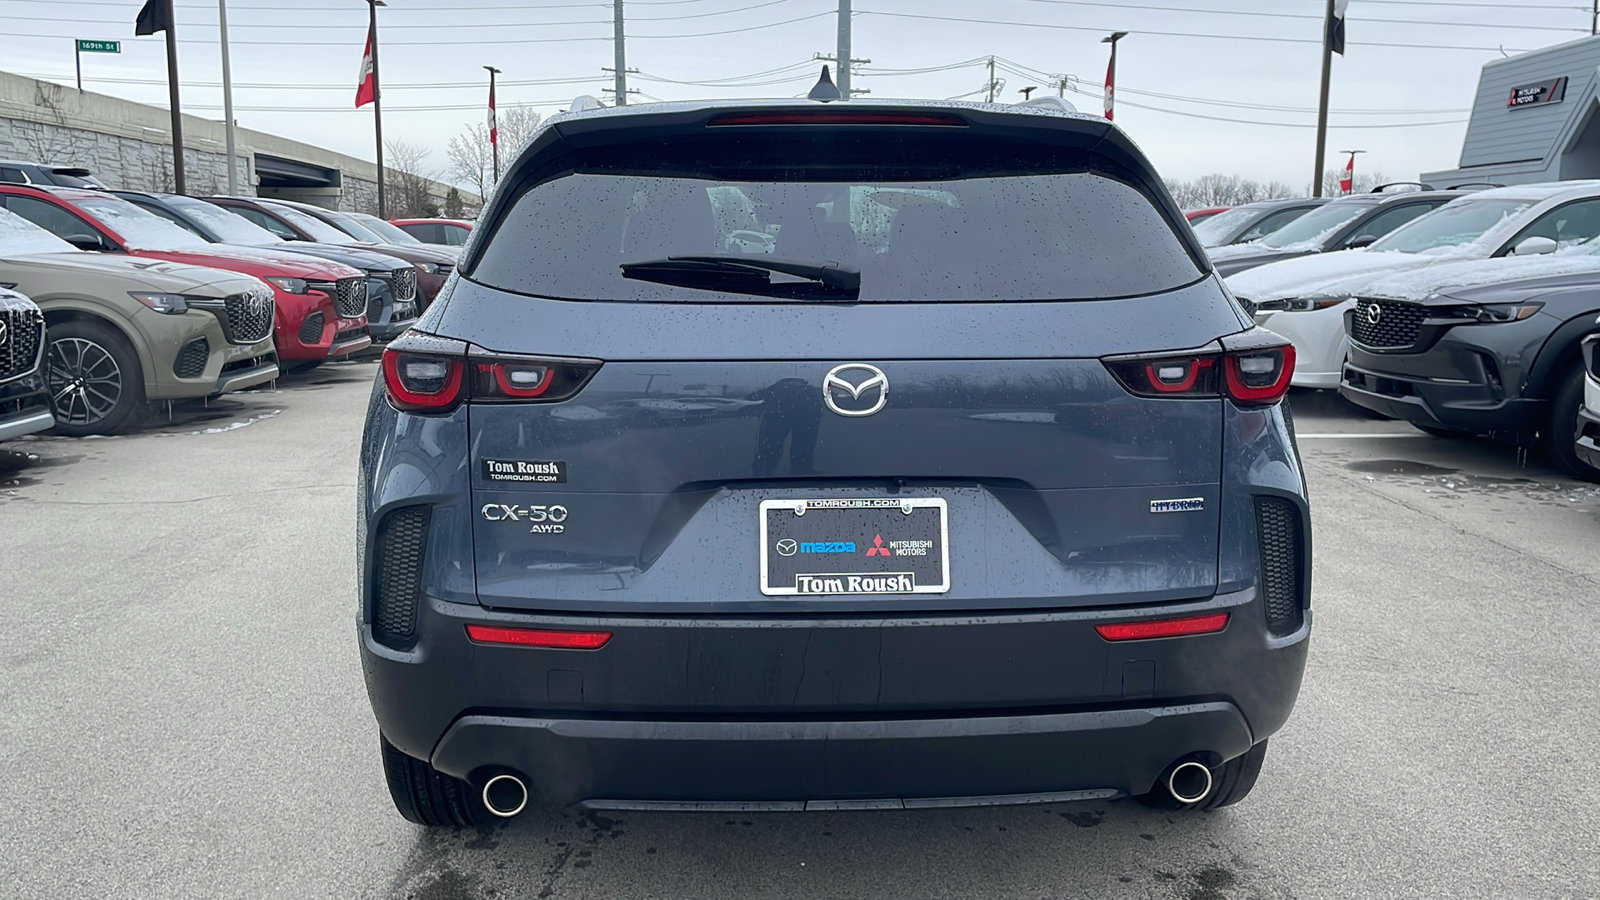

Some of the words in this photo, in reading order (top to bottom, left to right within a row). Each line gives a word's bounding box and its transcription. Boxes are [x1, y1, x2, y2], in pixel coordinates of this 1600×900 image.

[487, 460, 515, 473] Tom
[517, 461, 559, 474] Roush
[490, 473, 557, 482] TOMROUSH.COM
[1154, 498, 1202, 511] HYBRID
[481, 503, 568, 522] CX-50
[530, 525, 564, 533] AWD
[890, 540, 933, 549] MITSUBISHI
[896, 548, 927, 556] MOTORS
[798, 576, 844, 592] Tom
[847, 574, 912, 592] Roush
